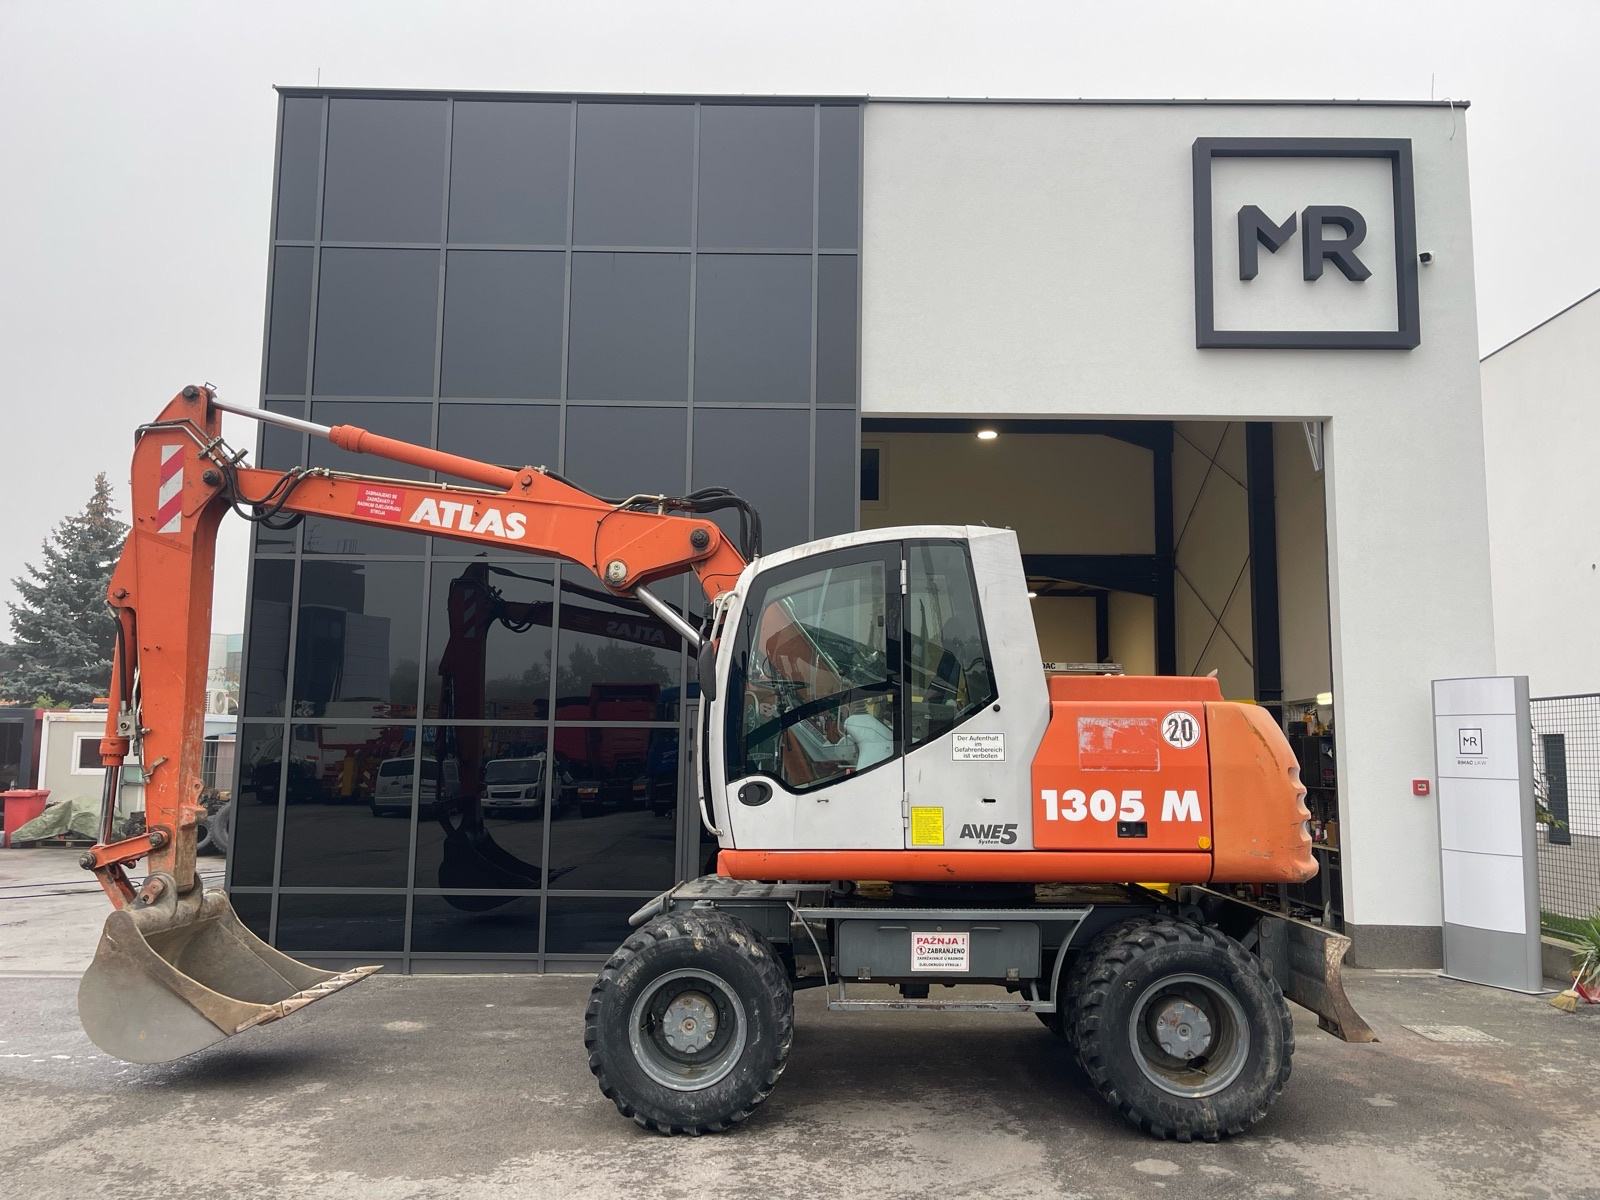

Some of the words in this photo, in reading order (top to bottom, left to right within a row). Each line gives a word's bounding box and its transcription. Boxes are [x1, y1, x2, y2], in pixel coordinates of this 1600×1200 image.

[1238, 205, 1372, 281] MR
[409, 498, 527, 539] ATLAS
[1168, 719, 1193, 742] 20
[1463, 736, 1477, 746] MR
[1041, 789, 1145, 821] 1305
[1161, 790, 1202, 822] M
[917, 936, 958, 944] PAŽNJA
